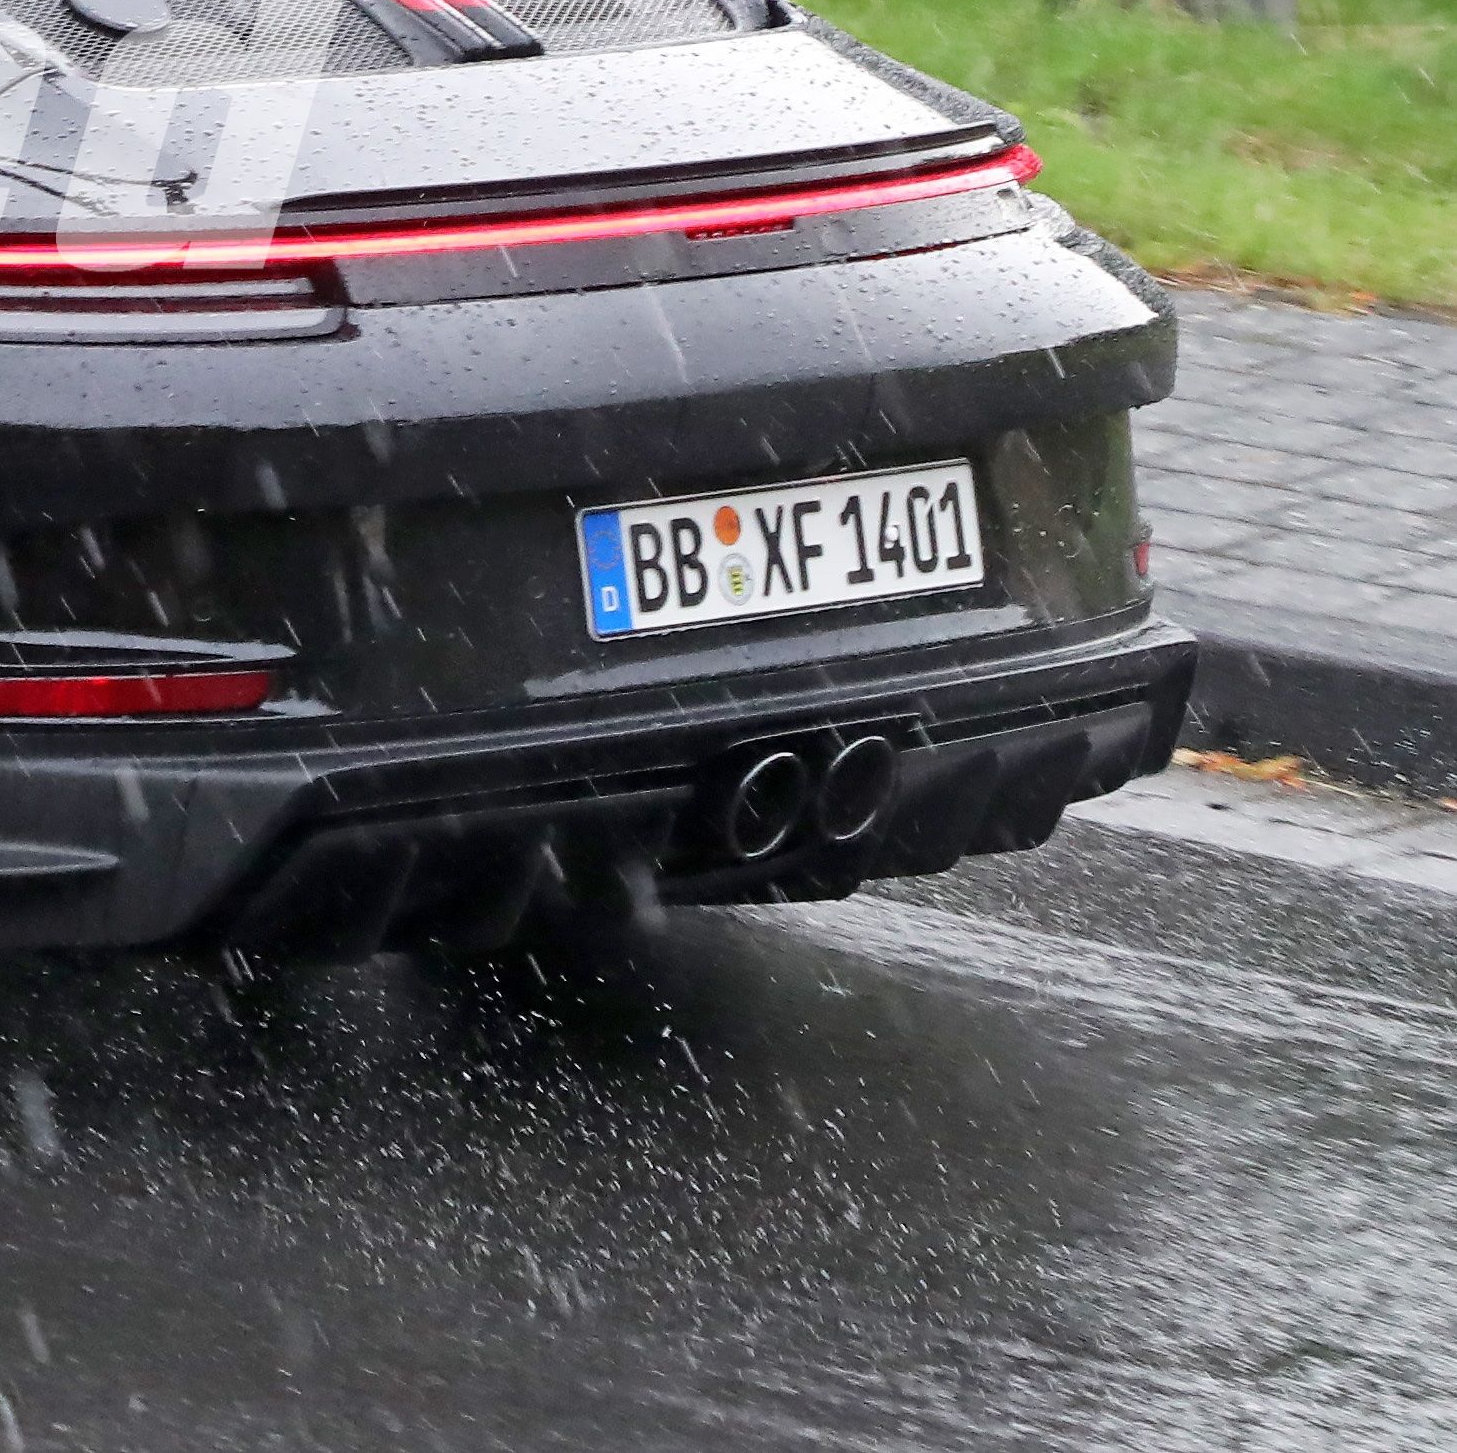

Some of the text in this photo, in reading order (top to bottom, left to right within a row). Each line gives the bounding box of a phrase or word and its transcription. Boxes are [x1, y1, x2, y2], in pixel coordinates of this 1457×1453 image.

[629, 482, 972, 613] BB XF 1401
[600, 585, 622, 613] D
